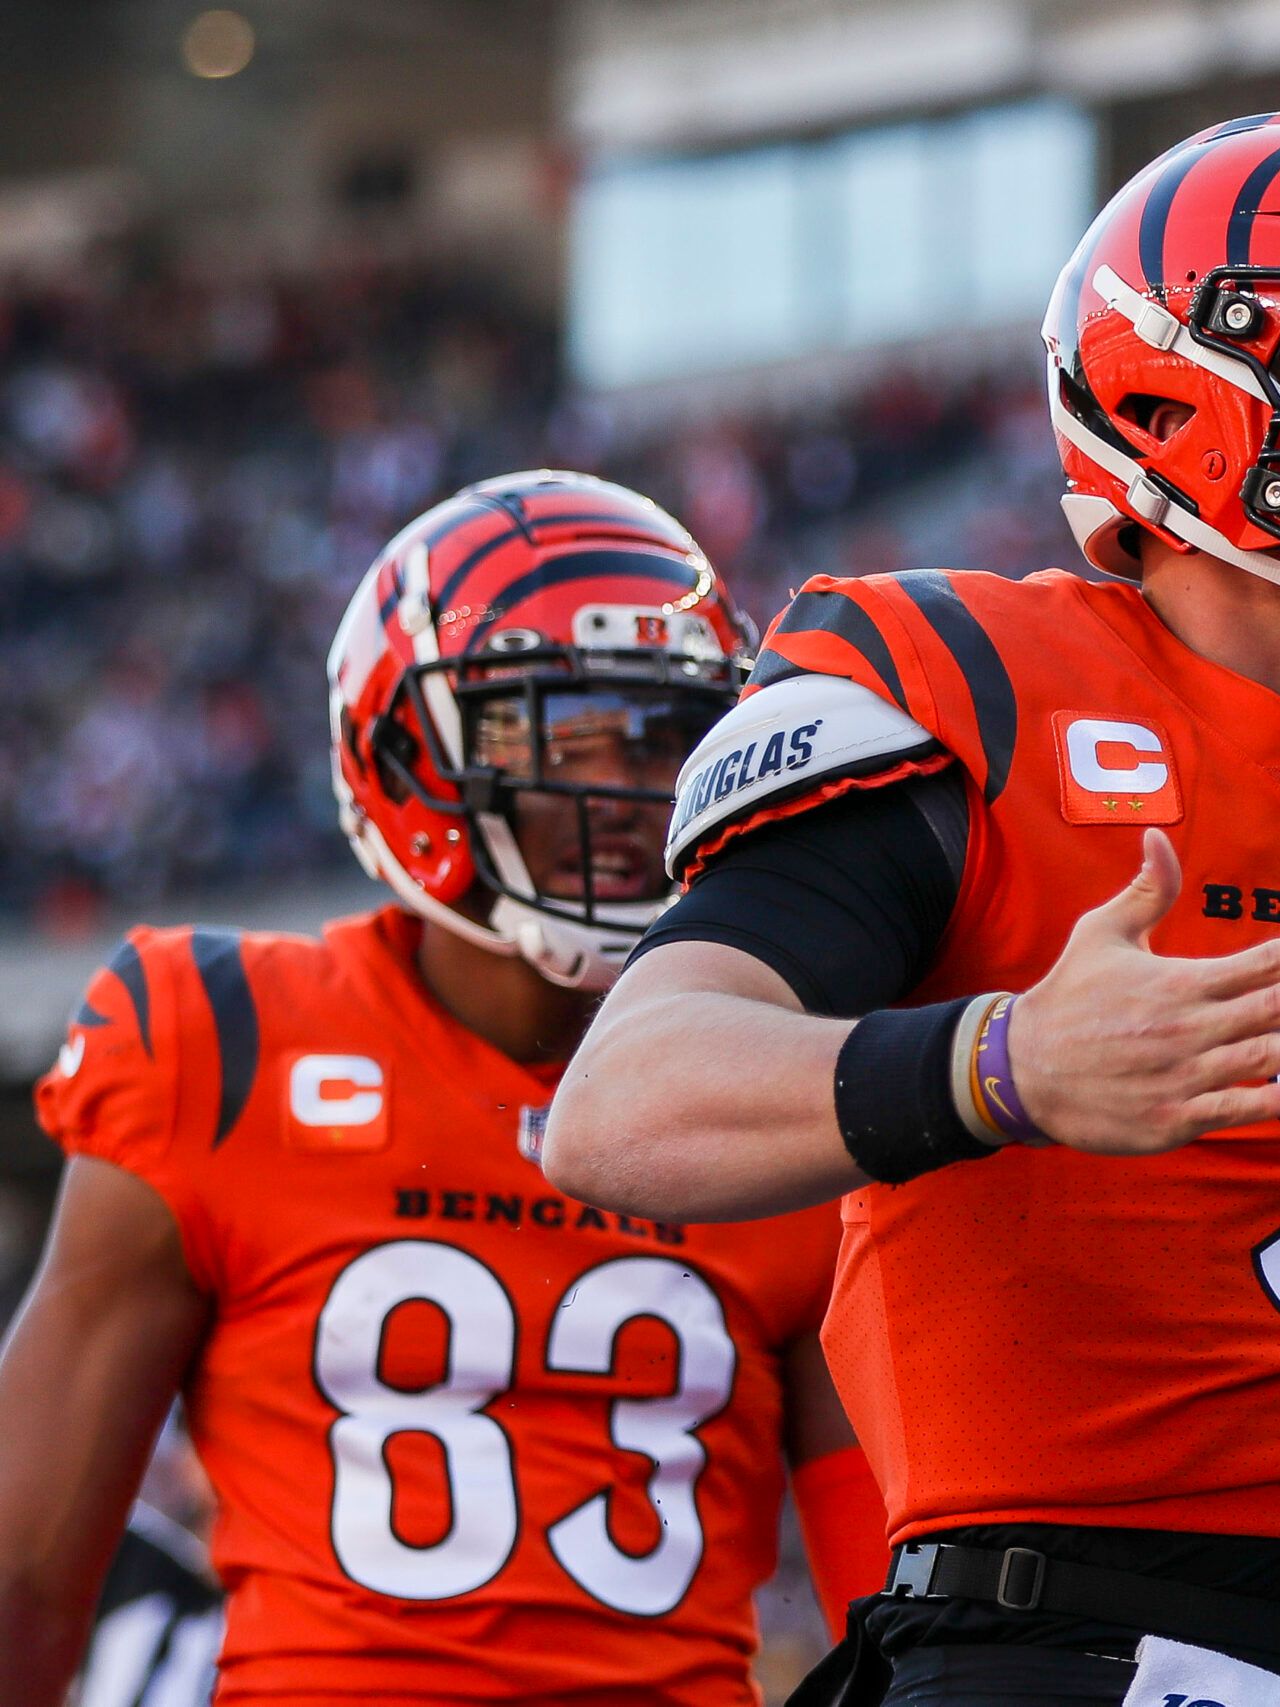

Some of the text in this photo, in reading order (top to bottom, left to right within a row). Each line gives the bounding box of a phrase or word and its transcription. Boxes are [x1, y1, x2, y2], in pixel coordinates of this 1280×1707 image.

[1066, 718, 1169, 794] C
[289, 1053, 384, 1127] C
[312, 1237, 740, 1620] 83
